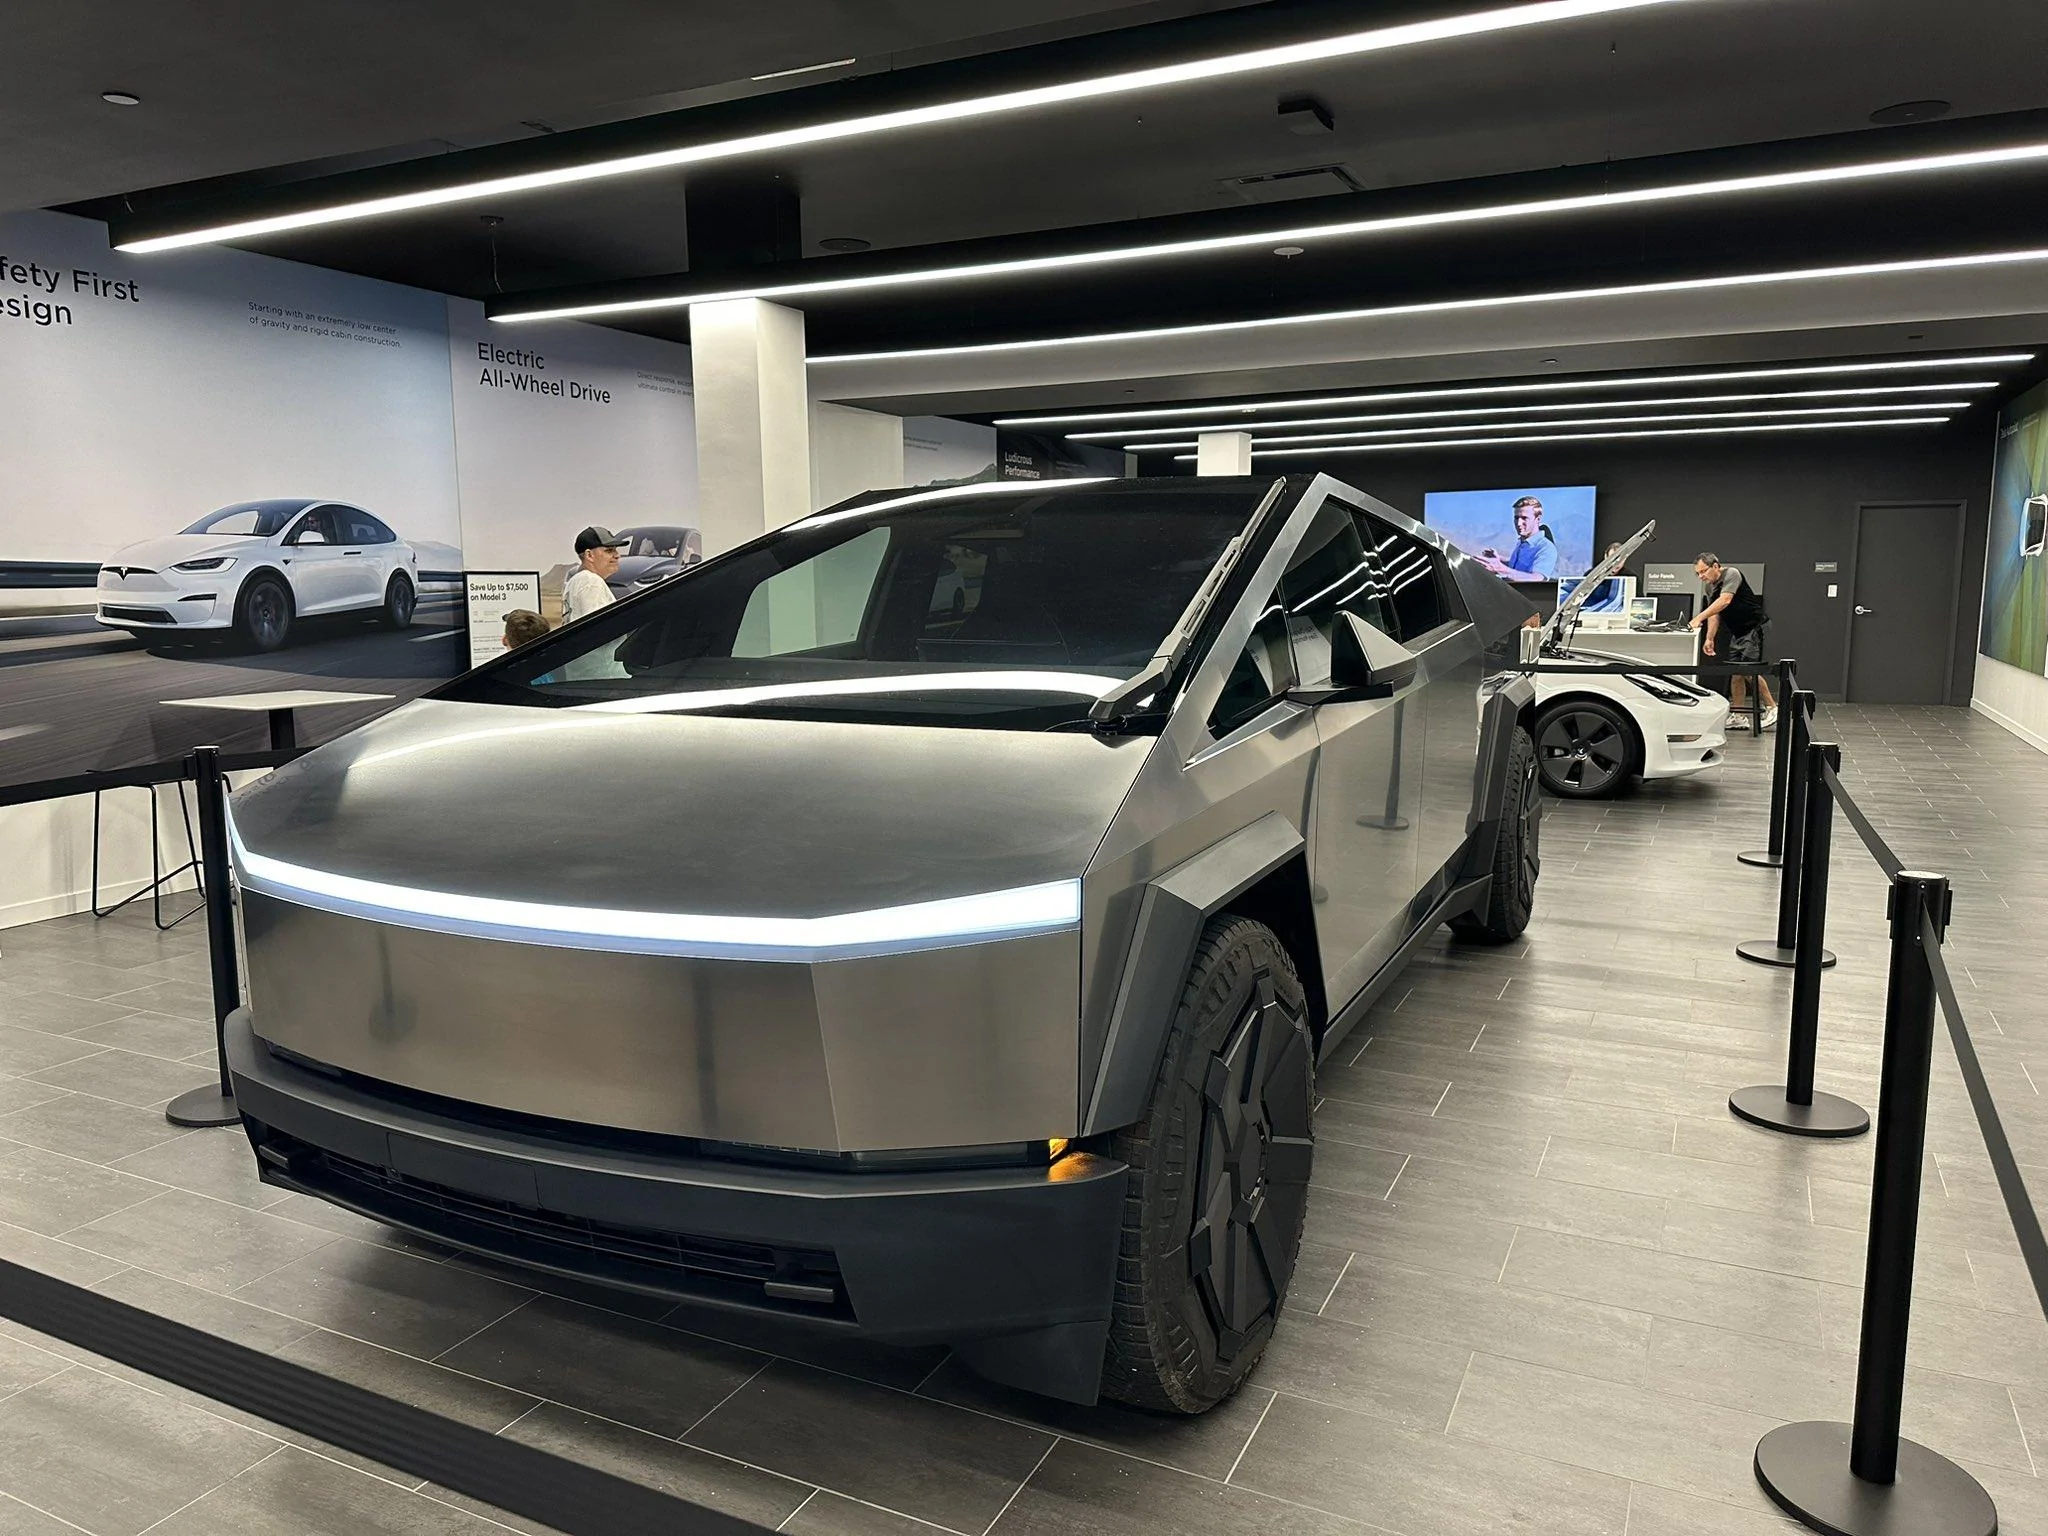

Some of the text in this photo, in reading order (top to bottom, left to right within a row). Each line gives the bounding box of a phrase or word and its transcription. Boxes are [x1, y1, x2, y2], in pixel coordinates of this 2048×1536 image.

[72, 269, 140, 302] First
[0, 294, 72, 326] sign
[248, 301, 283, 316] Starting
[284, 309, 304, 318] with
[317, 315, 356, 329] extremely
[357, 321, 371, 330] low
[372, 325, 397, 335] center
[249, 316, 259, 324] of
[260, 318, 291, 331] gravity
[292, 324, 308, 332] and
[309, 326, 329, 336] rigid
[330, 330, 352, 340] cabin
[478, 342, 545, 370] Electric
[480, 368, 611, 404] All-Wheel Drive
[1004, 451, 1033, 466] Ludicrous
[1004, 464, 1041, 479] Performance
[469, 583, 529, 592] Save Up to $7,500
[480, 593, 501, 601] Model
[502, 593, 507, 601] 3
